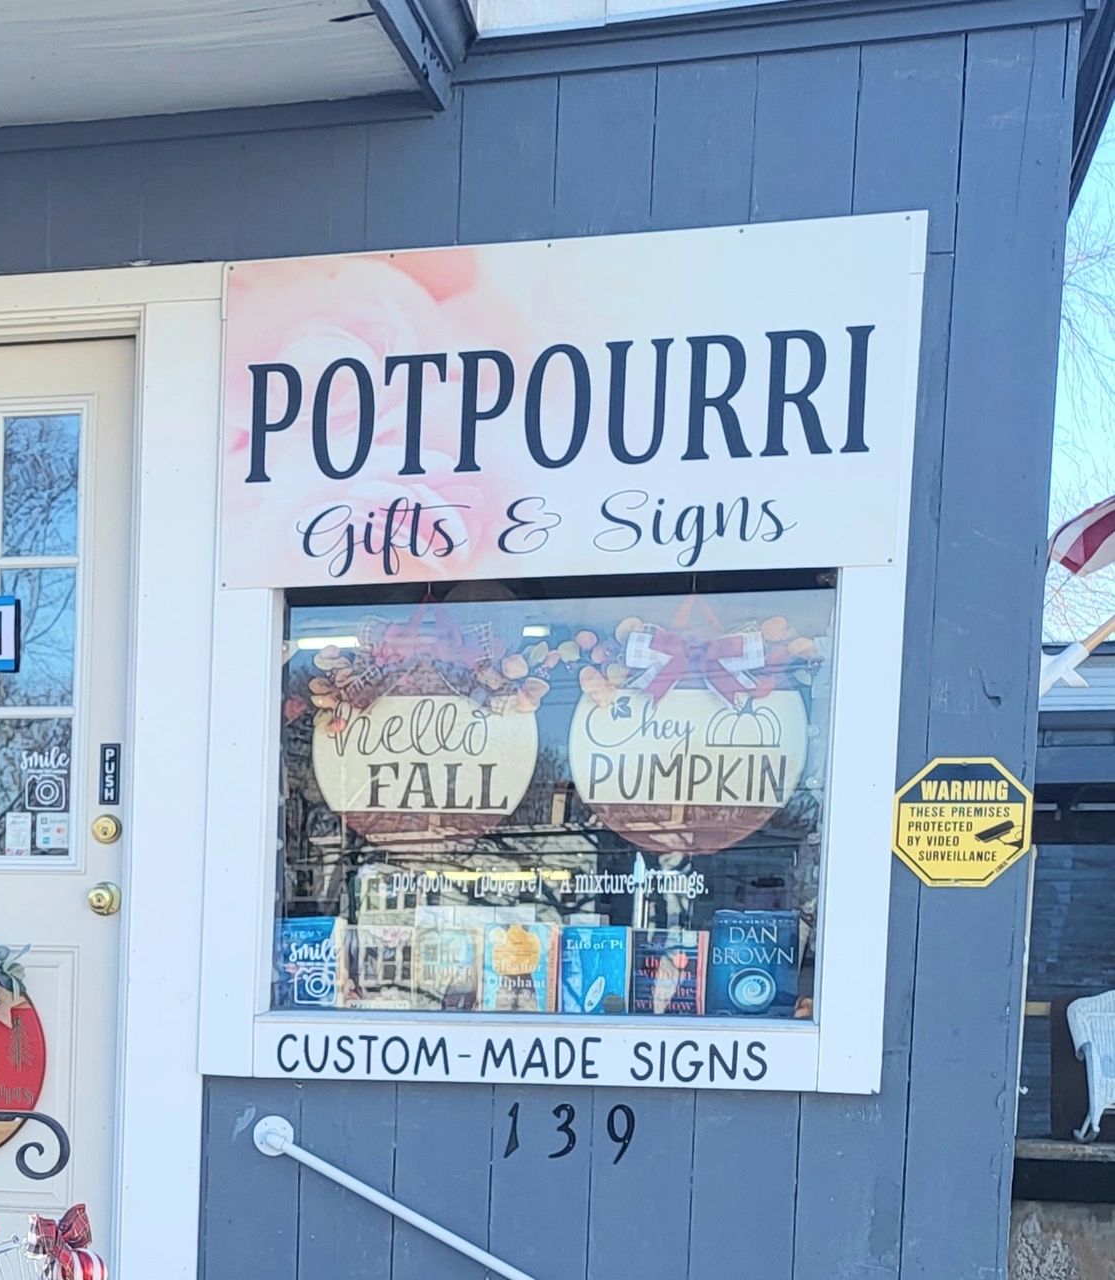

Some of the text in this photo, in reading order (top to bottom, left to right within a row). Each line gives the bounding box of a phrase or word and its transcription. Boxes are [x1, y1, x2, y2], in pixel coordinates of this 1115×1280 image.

[244, 324, 875, 484] POTPOURRI
[296, 489, 796, 578] Gifts & Signs
[327, 698, 492, 757] hello
[104, 748, 115, 801] PUSH
[366, 761, 508, 810] FALL
[588, 752, 787, 802] PUMPKIN
[920, 779, 1010, 801] WARNING
[909, 806, 1011, 818] THESE PREMISES
[907, 820, 974, 832] PROTECTED
[906, 835, 960, 847] BY VIDEO
[917, 849, 998, 862] SURVEILLANCE
[574, 869, 636, 894] mixture
[592, 938, 607, 950] of
[610, 938, 624, 950] Pi
[729, 925, 778, 944] DAN
[712, 946, 795, 965] BROWN
[277, 1033, 769, 1083] CUSTOM-MADE SIGNS
